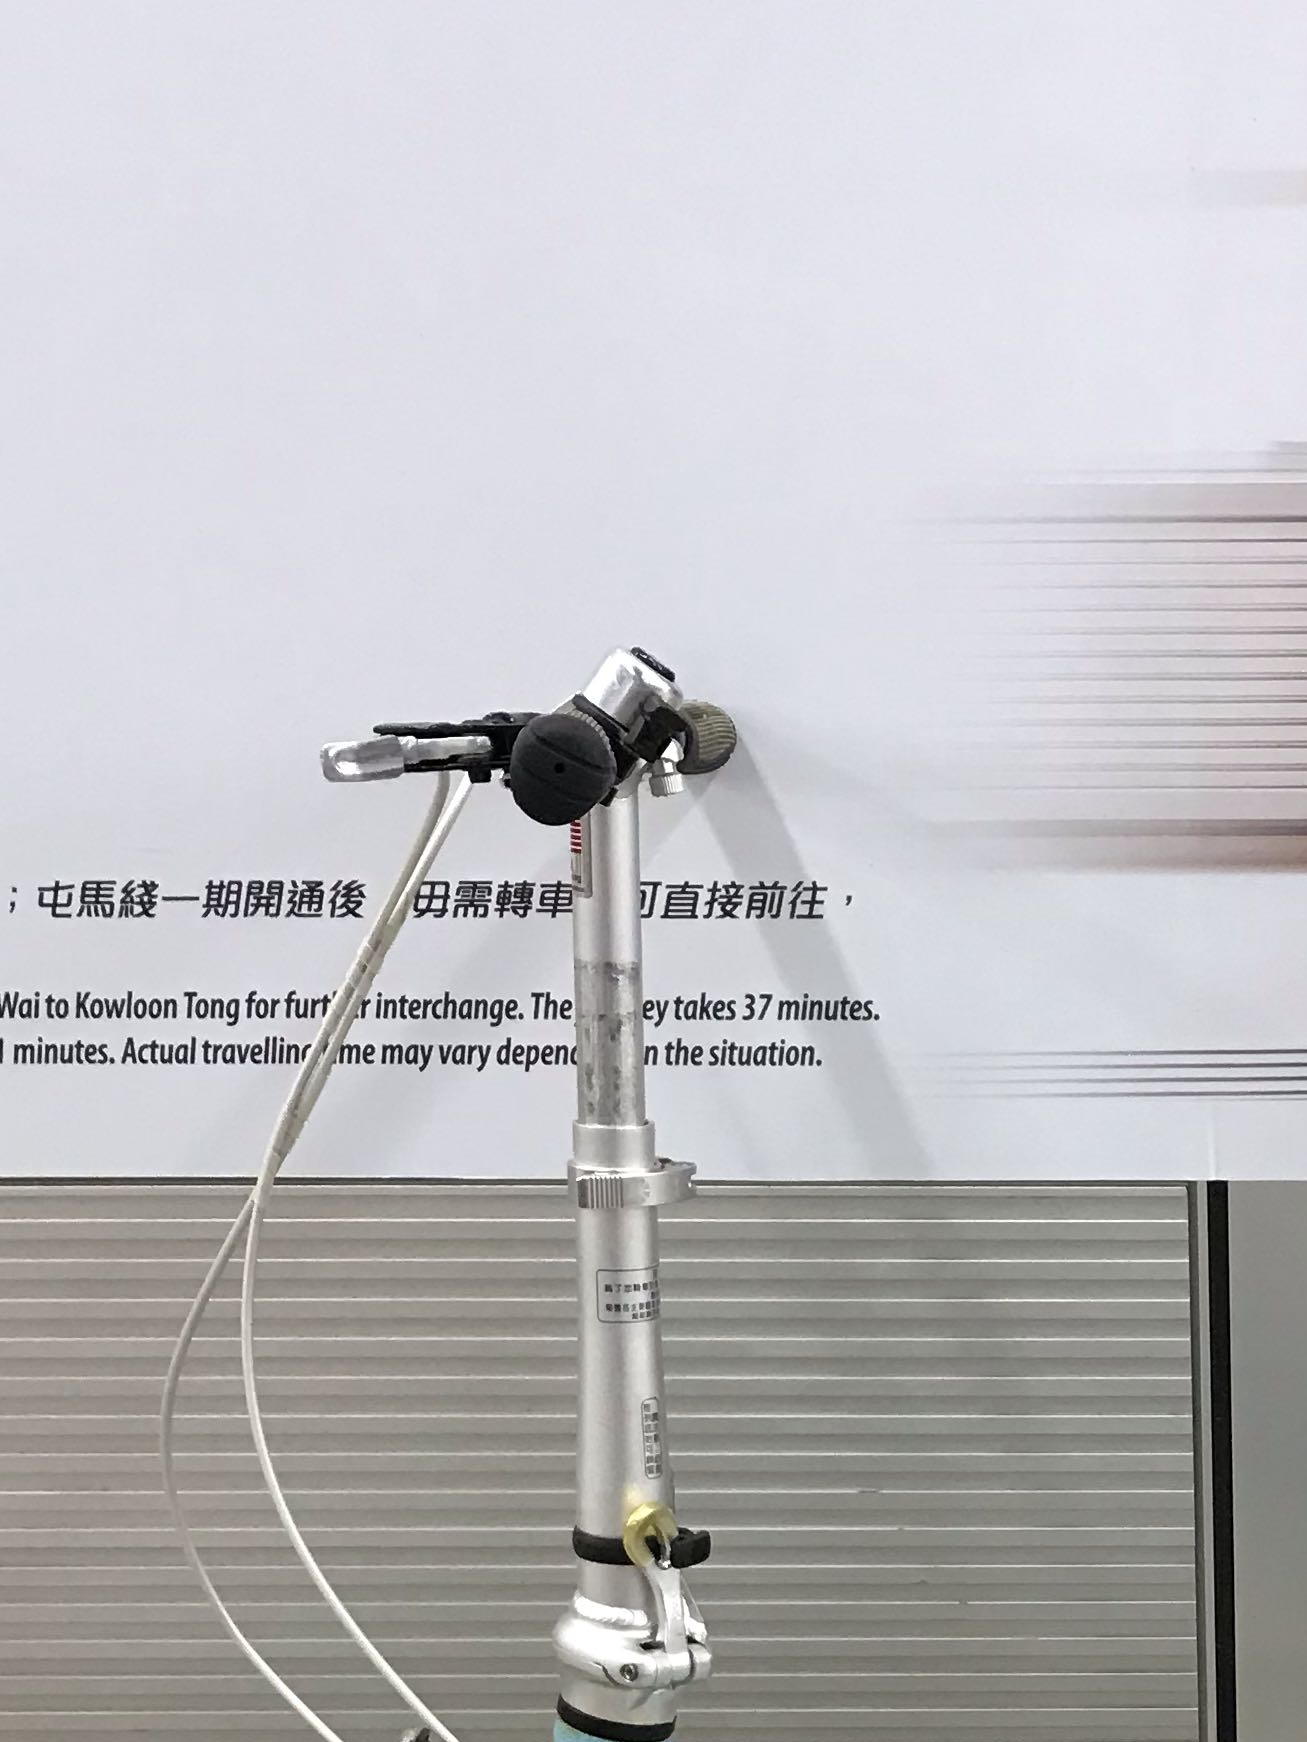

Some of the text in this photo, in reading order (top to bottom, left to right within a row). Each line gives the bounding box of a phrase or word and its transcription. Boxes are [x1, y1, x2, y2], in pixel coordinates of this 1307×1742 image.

[46, 994, 69, 1019] to
[75, 991, 178, 1019] Kowloon
[184, 991, 240, 1026] Tong
[246, 991, 280, 1019] for
[284, 991, 371, 1019] furtr
[375, 992, 525, 1027] interchange.
[531, 992, 573, 1020] The
[674, 992, 737, 1021] takes
[742, 993, 773, 1021] 37
[777, 993, 880, 1021] minutes.
[13, 1036, 116, 1065] minutes.
[121, 1037, 197, 1065] Actual
[381, 1044, 434, 1072] may
[439, 1044, 492, 1072] vary
[665, 1038, 704, 1066] the
[708, 1039, 823, 1067] situation.
